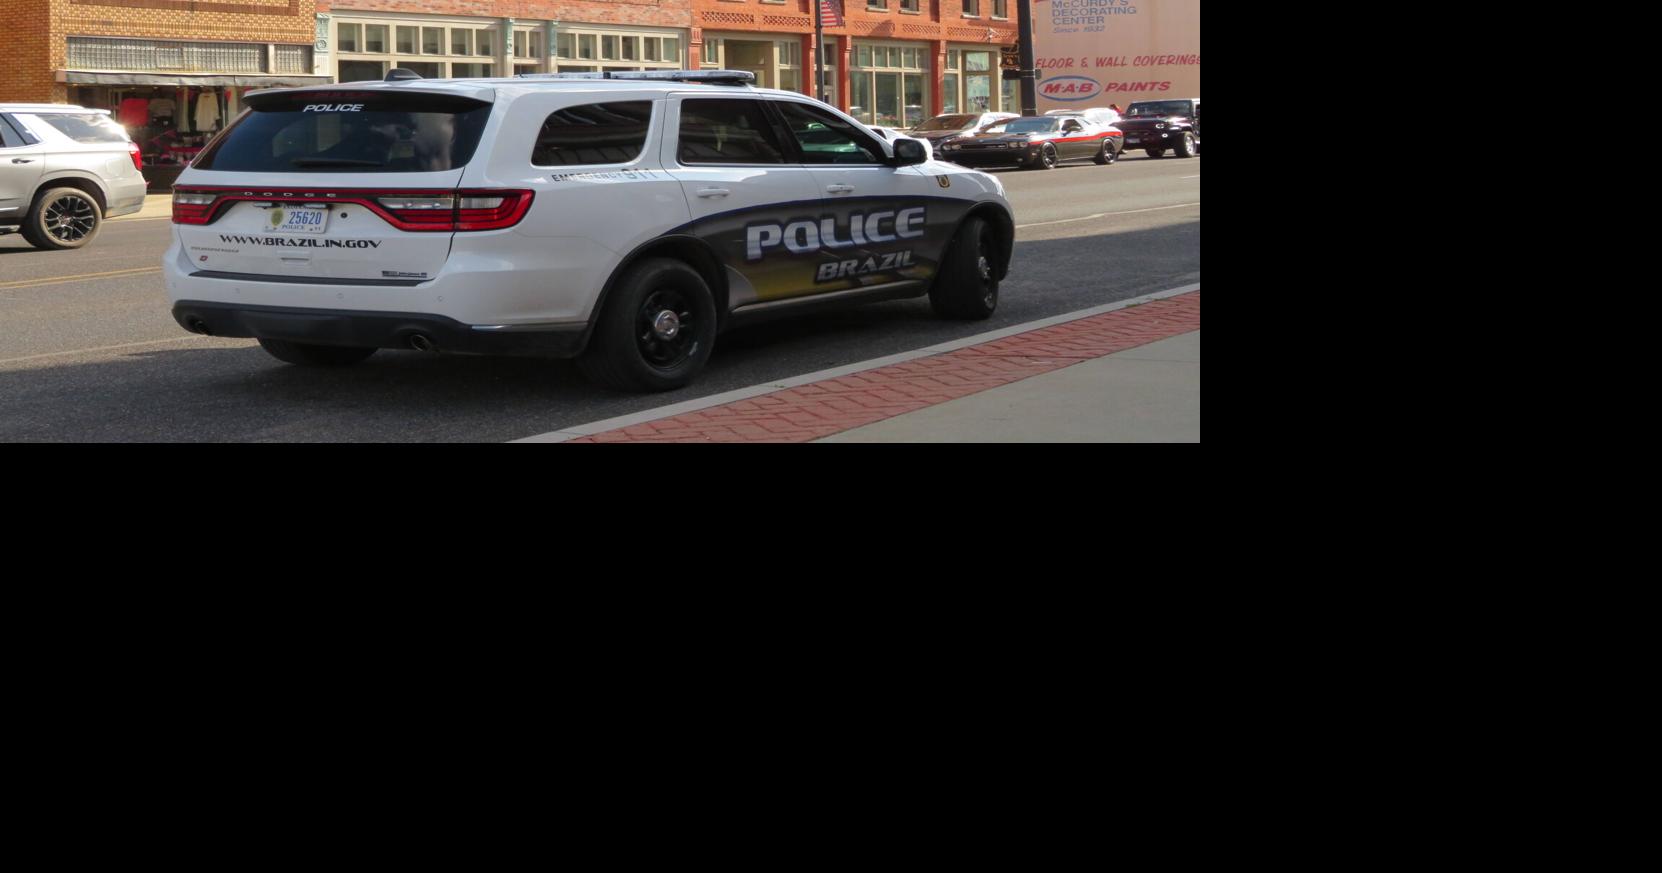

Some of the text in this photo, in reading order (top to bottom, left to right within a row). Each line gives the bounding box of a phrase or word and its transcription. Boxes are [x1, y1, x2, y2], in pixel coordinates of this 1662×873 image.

[1052, 7, 1137, 17] DECORATING
[1052, 16, 1105, 25] CENTER
[1035, 57, 1074, 69] FLOOR
[1081, 57, 1089, 67] &
[1096, 56, 1128, 67] WALL
[1105, 81, 1171, 93] PAINTS
[303, 104, 364, 112] POLICE
[288, 211, 322, 225] 25620
[747, 207, 925, 261] POLICE
[219, 234, 382, 249] WWW.BRAZIL.IN.GOV
[817, 250, 916, 281] BRAZIL
